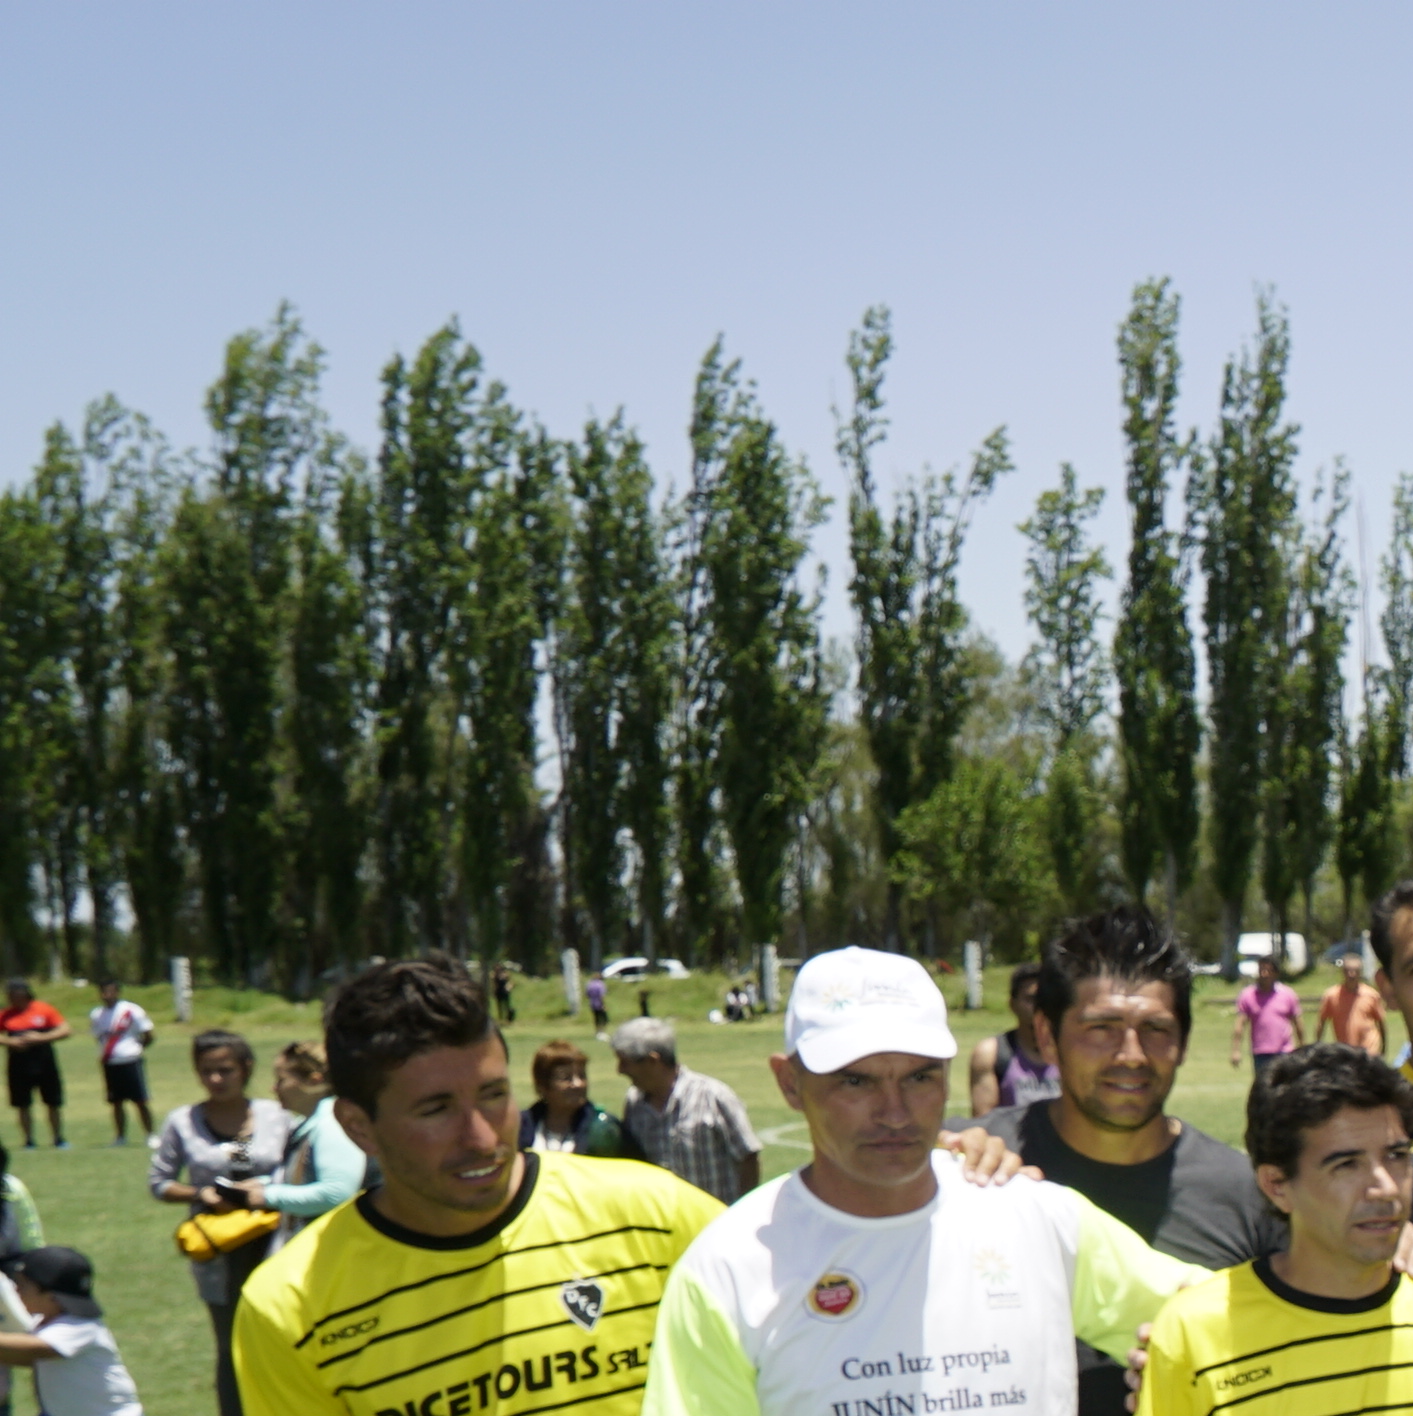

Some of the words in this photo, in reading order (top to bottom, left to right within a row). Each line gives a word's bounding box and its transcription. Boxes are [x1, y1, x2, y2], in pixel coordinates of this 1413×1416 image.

[841, 1358, 892, 1380] Con
[897, 1353, 933, 1375] luz
[941, 1344, 1011, 1377] propia
[923, 1388, 983, 1414] brilla
[990, 1385, 1027, 1407] más
